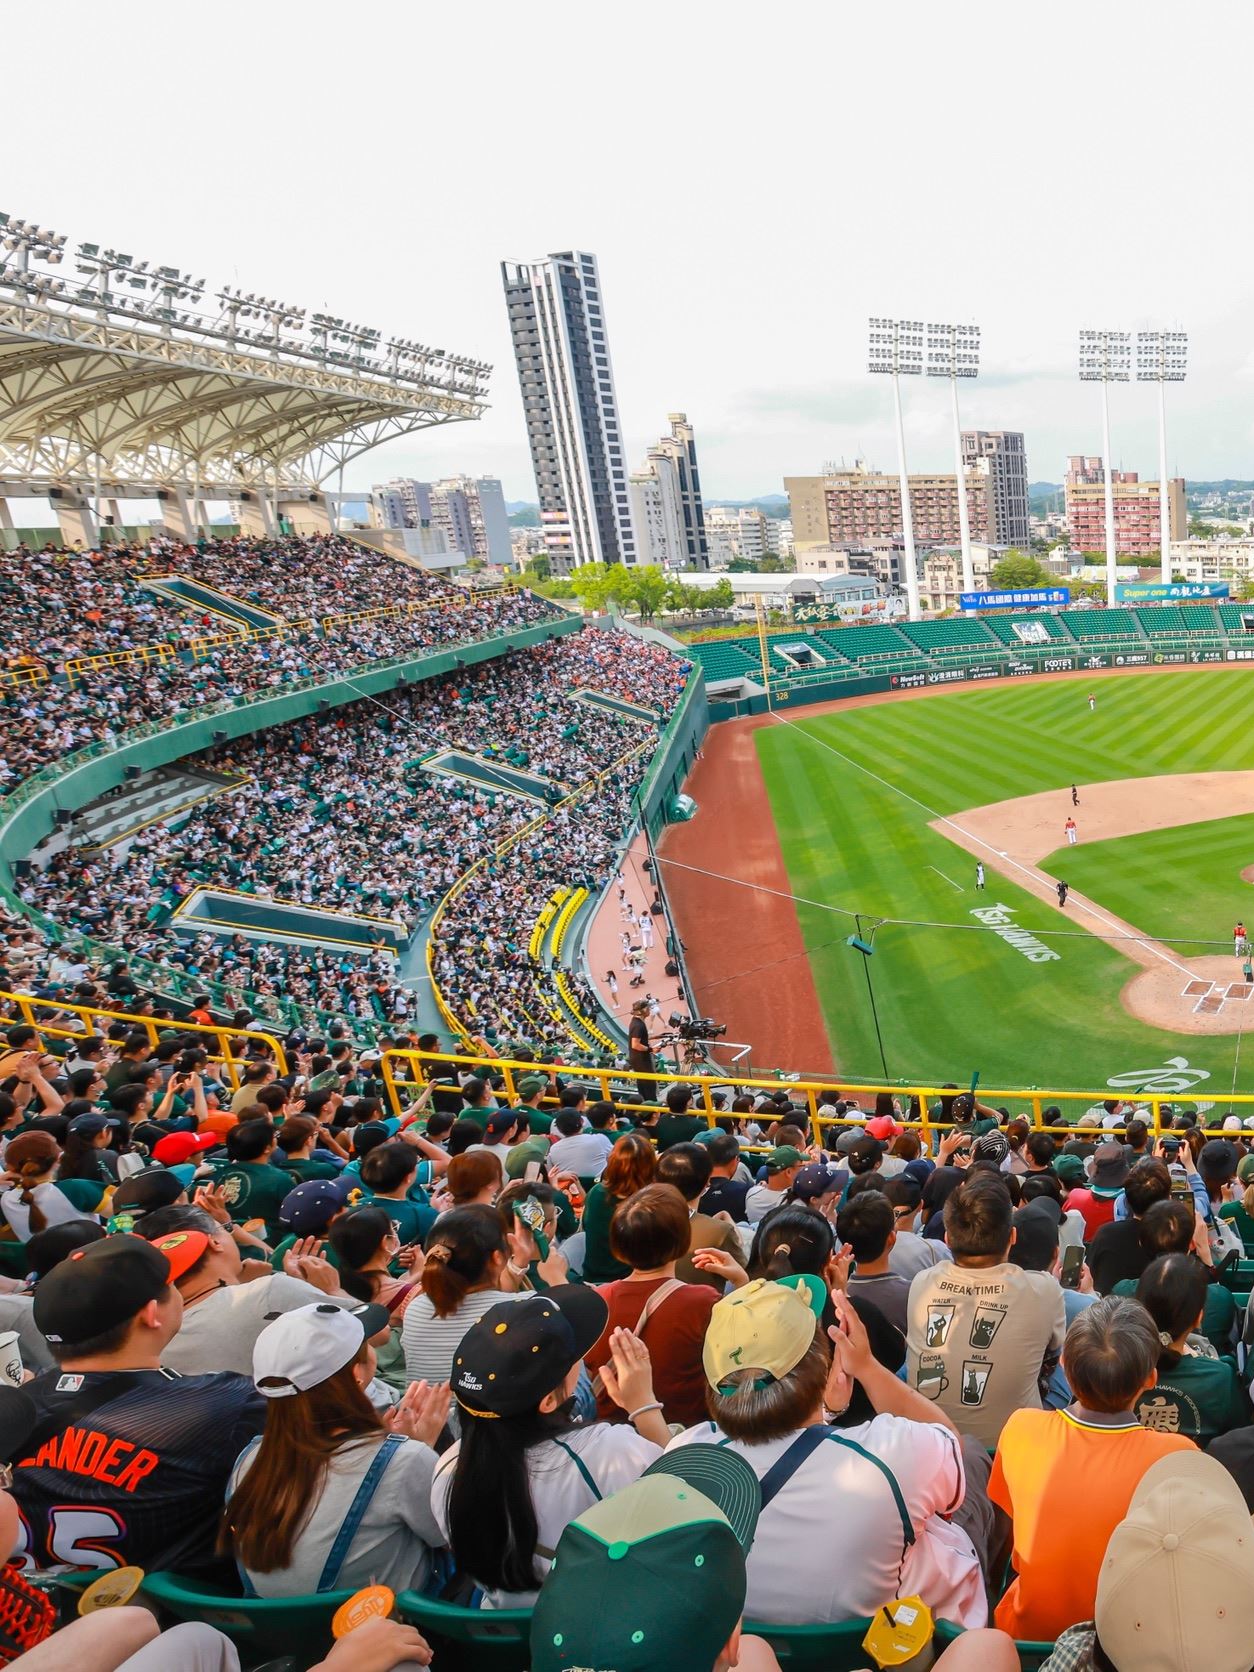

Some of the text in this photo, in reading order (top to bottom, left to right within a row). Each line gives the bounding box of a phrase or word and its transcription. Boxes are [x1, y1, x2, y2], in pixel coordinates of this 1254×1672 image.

[1123, 589, 1149, 598] Super
[1044, 659, 1072, 668] FOOTER
[994, 922, 1061, 963] HAWKS
[940, 1281, 1005, 1296] BREAK TIME!
[979, 1300, 998, 1309] DRINK
[922, 1354, 942, 1363] COCOA
[458, 1380, 483, 1390] HAWKS
[1154, 1384, 1184, 1397] HAWKS
[17, 1425, 160, 1493] ANDER
